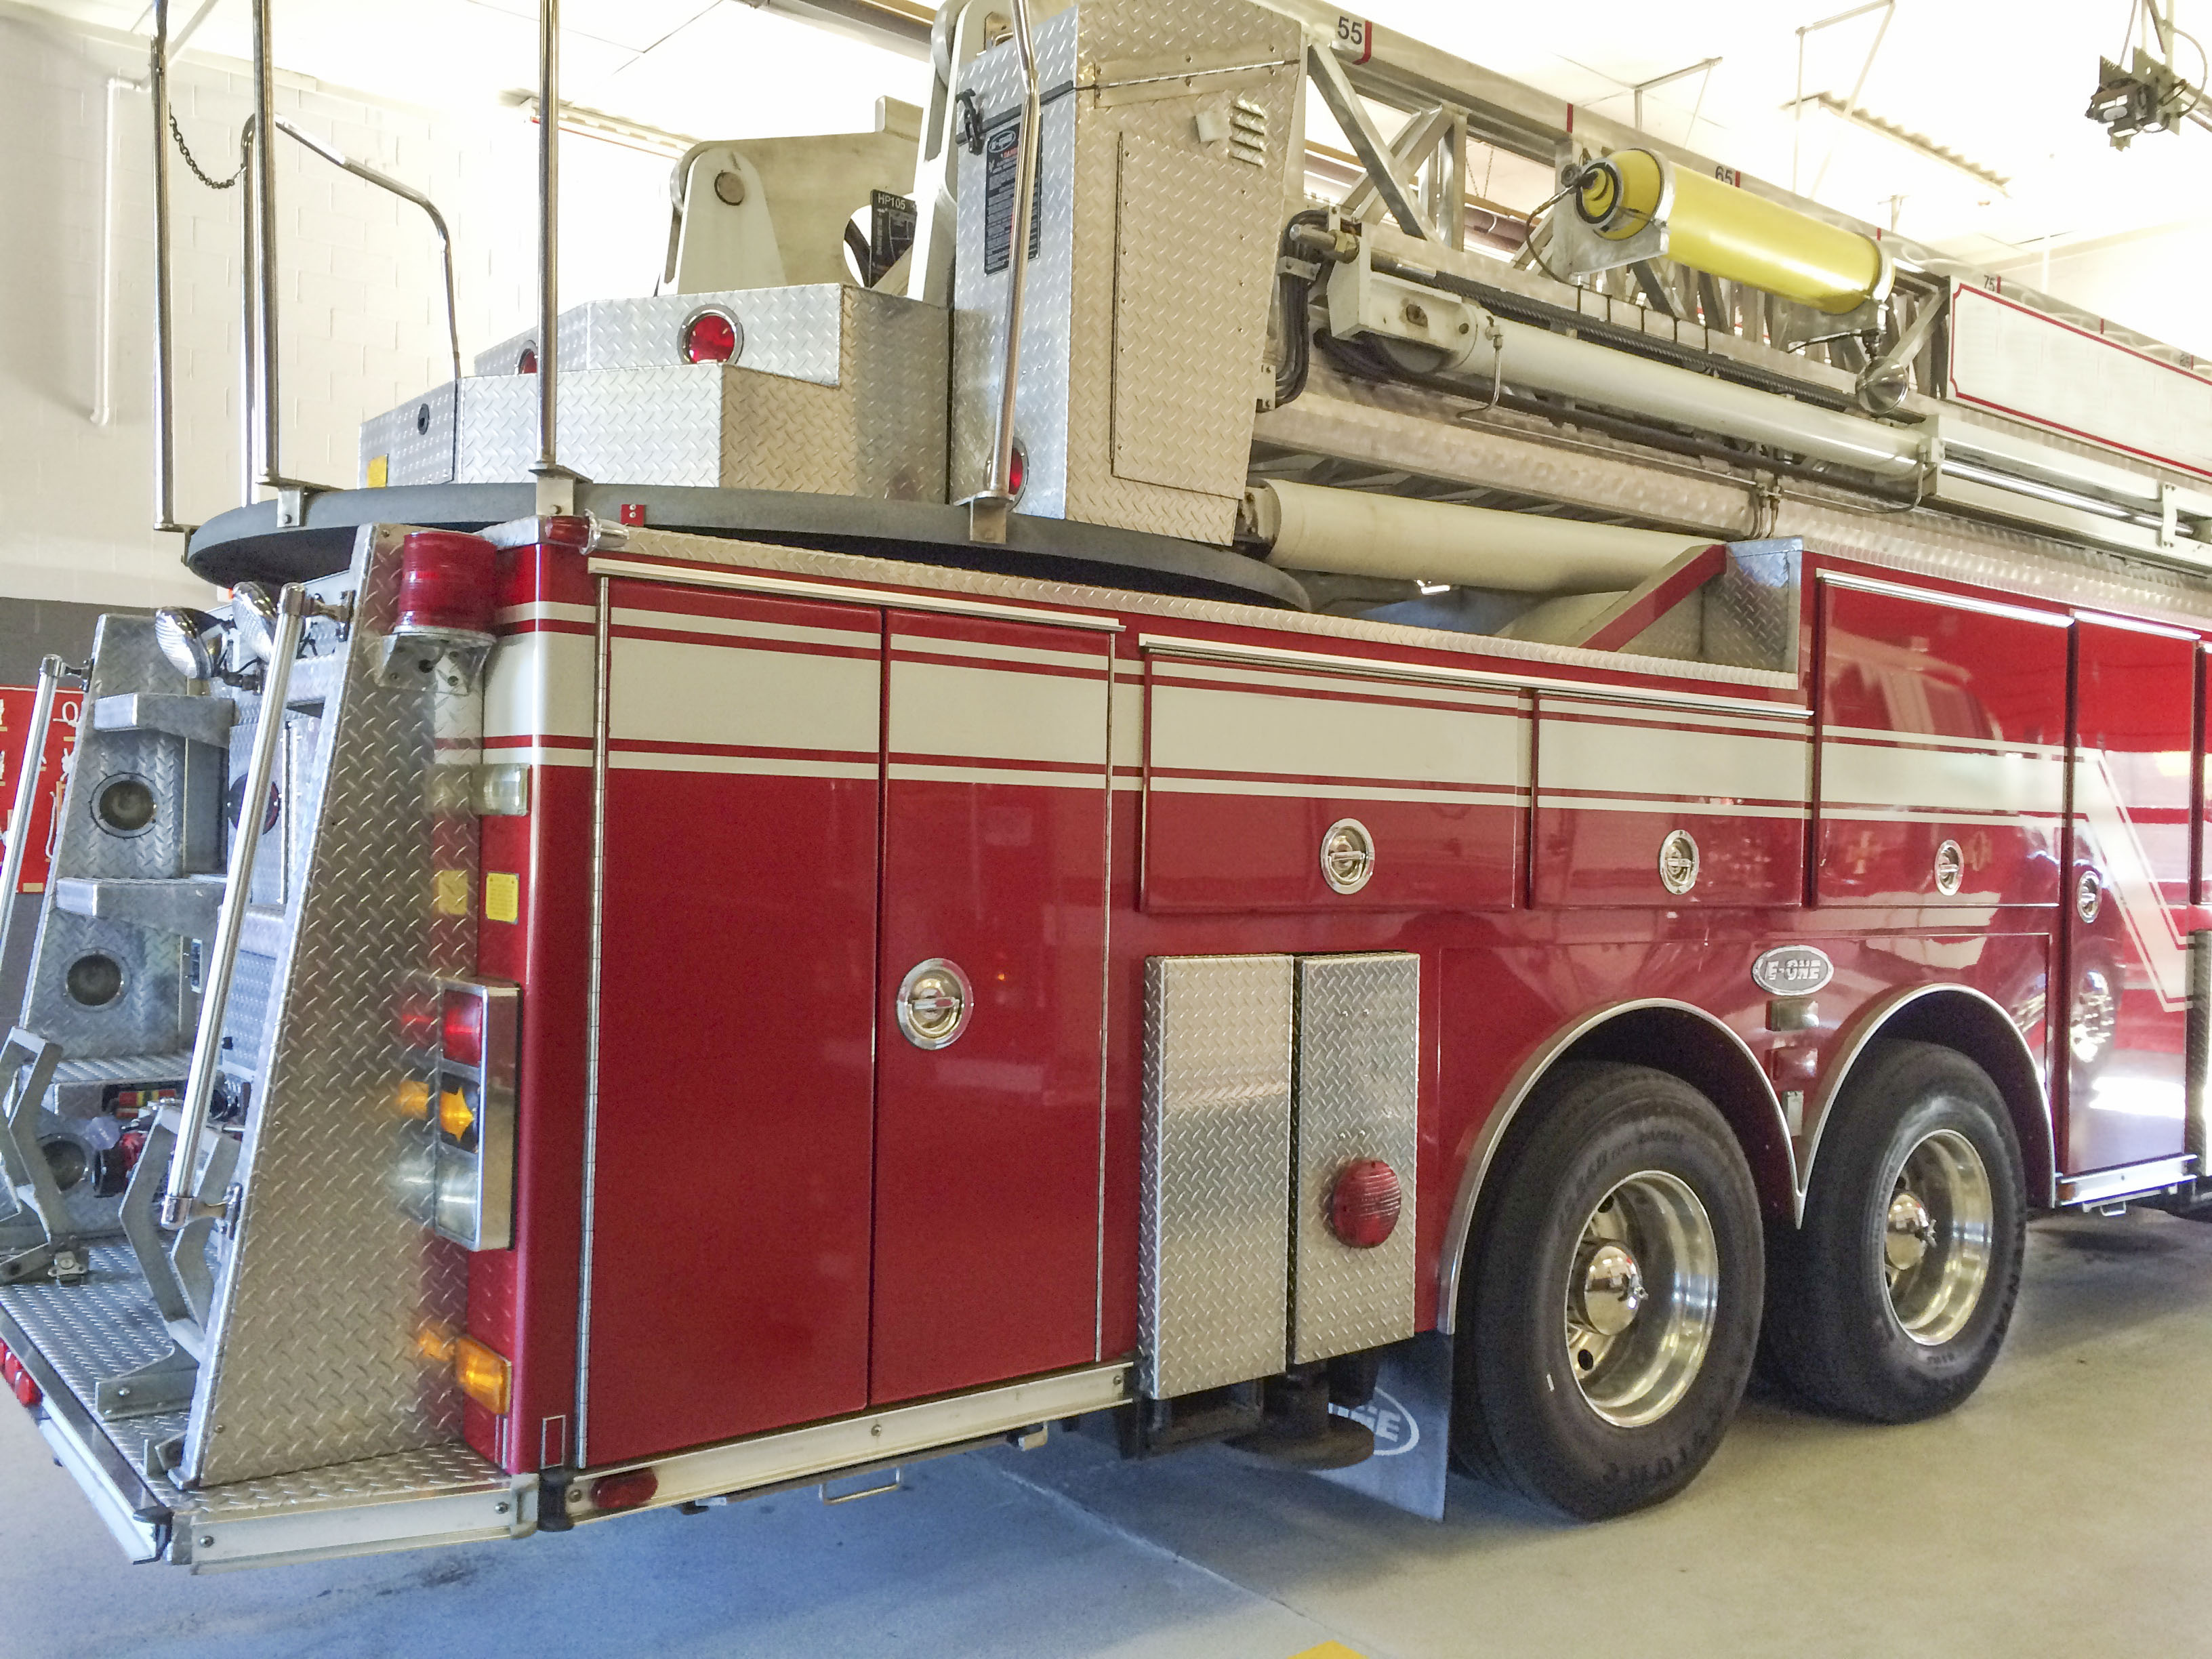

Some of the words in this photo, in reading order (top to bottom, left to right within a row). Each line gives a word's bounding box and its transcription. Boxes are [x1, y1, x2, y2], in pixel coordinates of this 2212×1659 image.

[1337, 16, 1362, 45] 55
[1715, 165, 1733, 185] 65
[878, 192, 907, 210] HP105
[1984, 274, 1995, 292] 75
[1765, 959, 1821, 981] E-ONE
